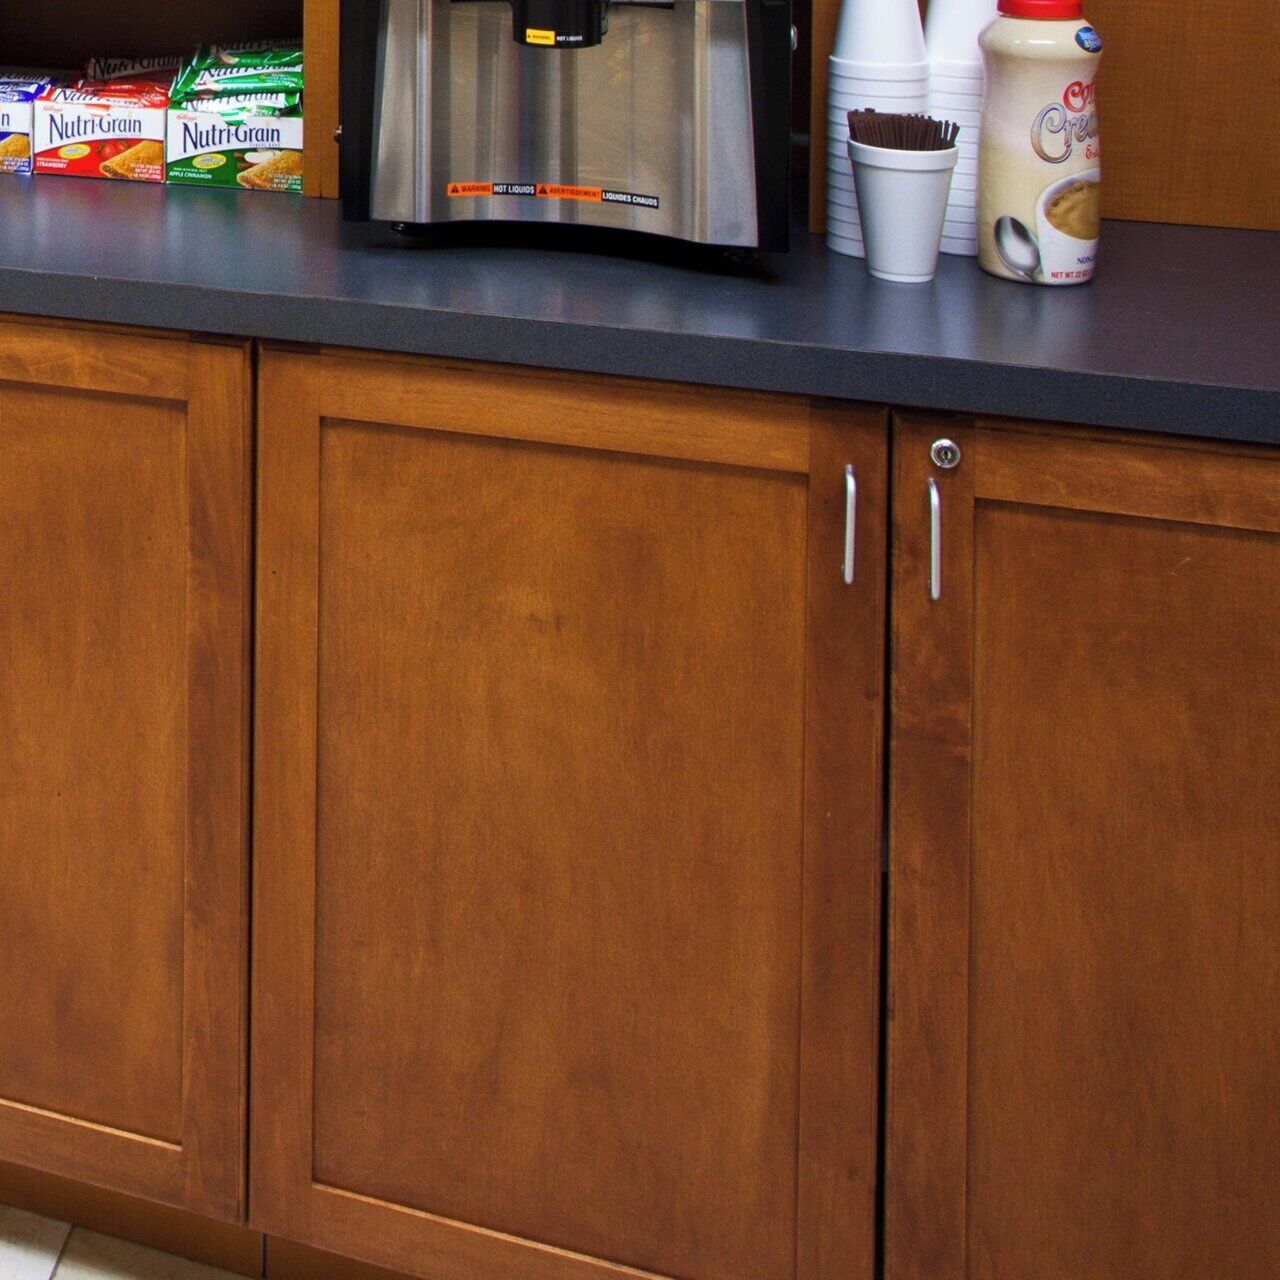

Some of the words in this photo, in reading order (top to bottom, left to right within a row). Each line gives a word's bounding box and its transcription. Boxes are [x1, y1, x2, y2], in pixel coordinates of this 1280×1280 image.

[36, 161, 68, 169] STRAWBERRY
[185, 171, 212, 179] CINNAMON
[461, 185, 491, 193] WARNING
[493, 185, 507, 193] HOT
[508, 185, 535, 194] LIQUIDS
[549, 188, 600, 198] AVERTISSEMENT
[602, 192, 631, 203] LIQUIDES
[632, 195, 658, 206] CHAUDS
[1050, 271, 1063, 279] NET
